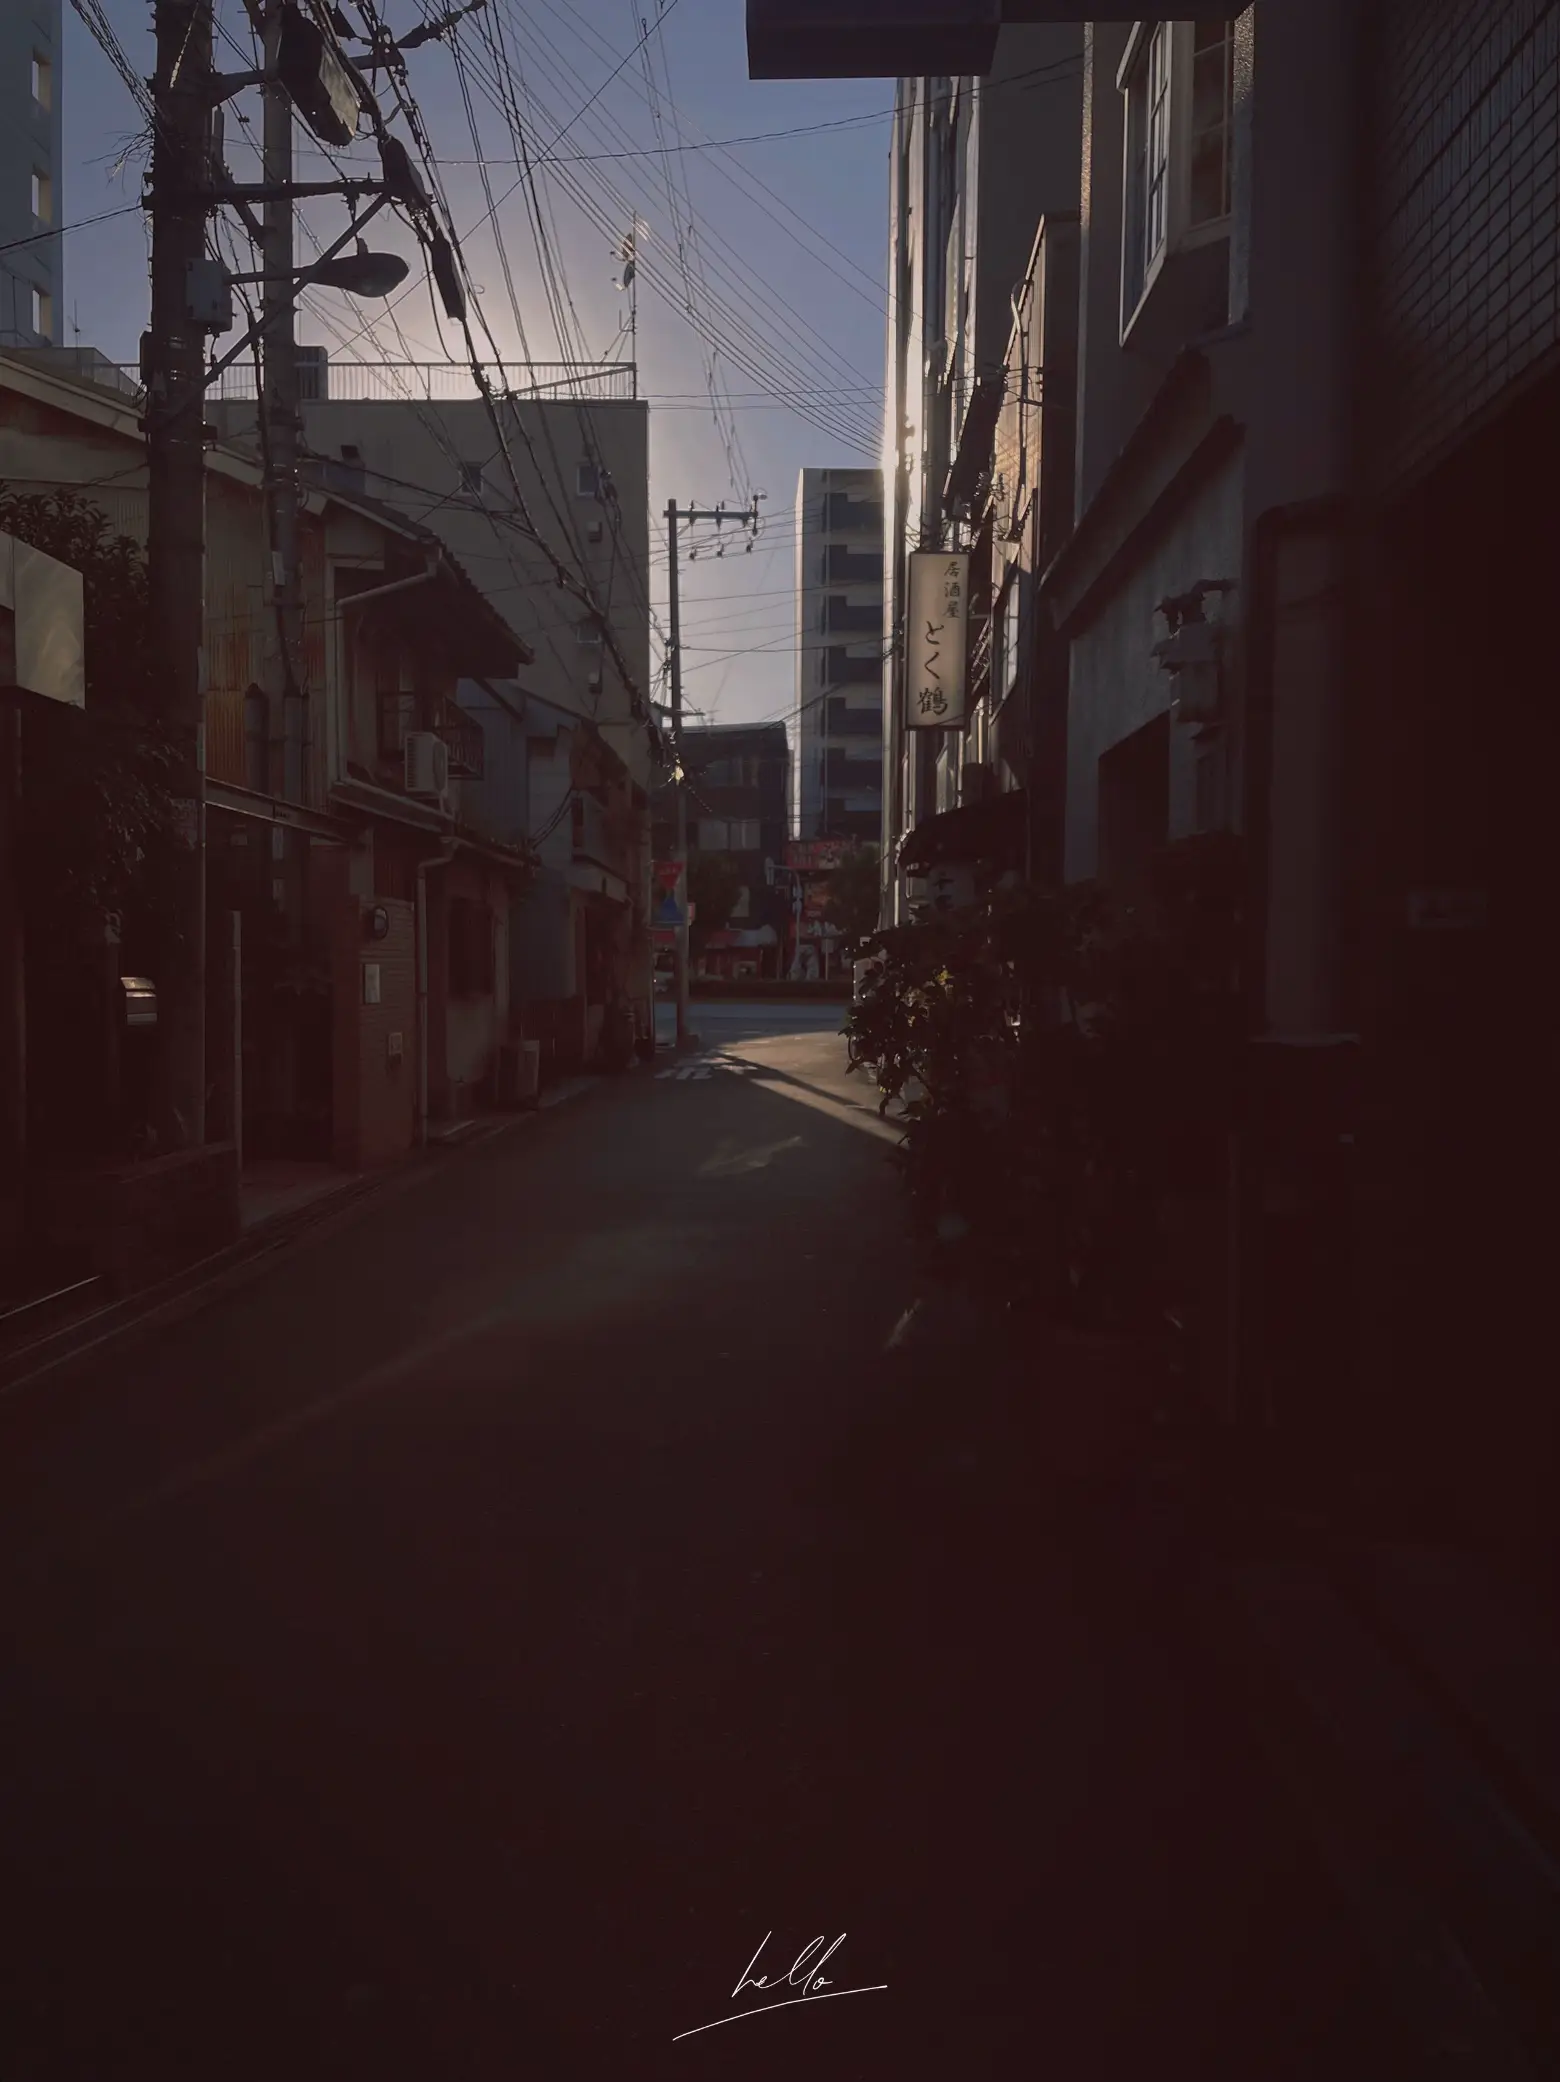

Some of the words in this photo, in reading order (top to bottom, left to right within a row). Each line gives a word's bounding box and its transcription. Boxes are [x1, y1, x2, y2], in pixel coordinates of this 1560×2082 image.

[943, 561, 961, 619] 居酒屋
[917, 620, 949, 716] とく鶴
